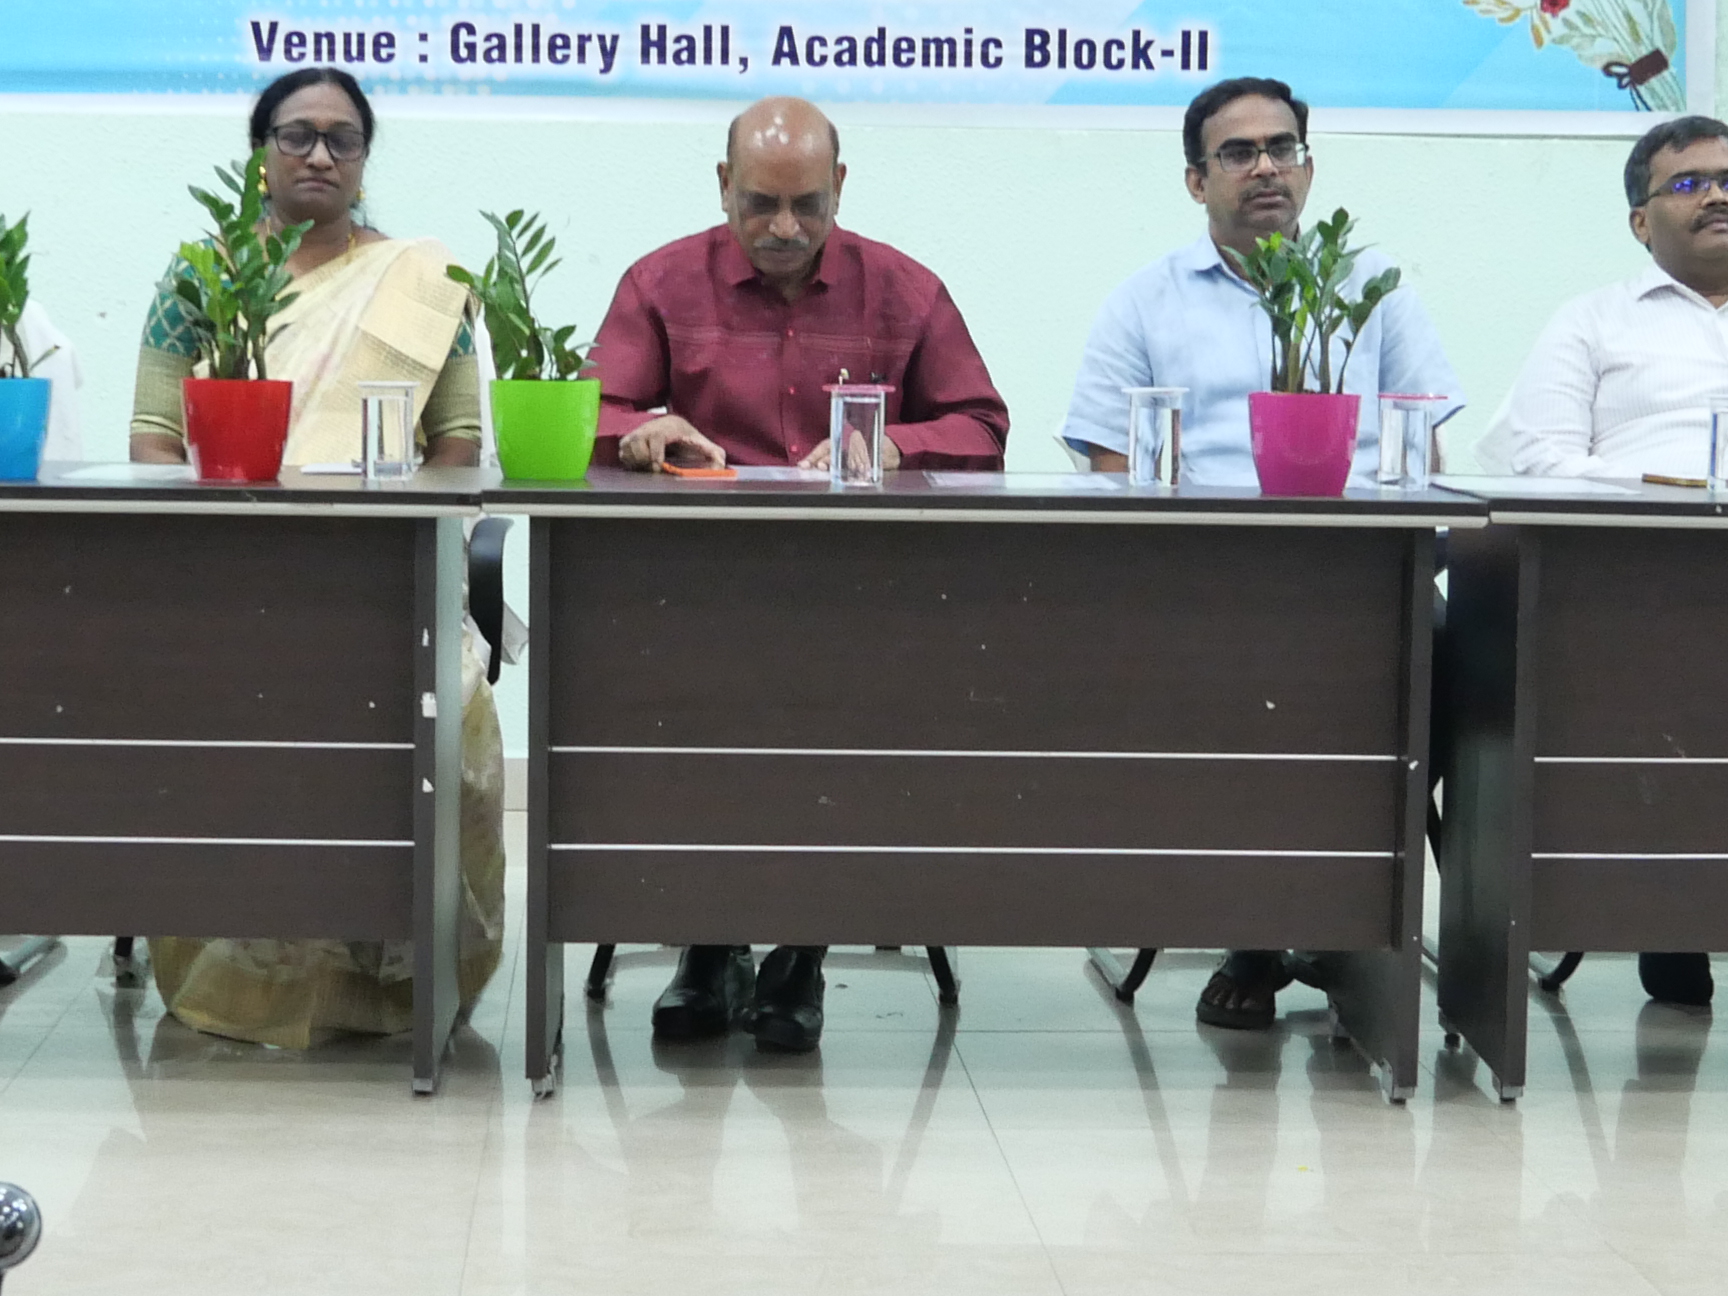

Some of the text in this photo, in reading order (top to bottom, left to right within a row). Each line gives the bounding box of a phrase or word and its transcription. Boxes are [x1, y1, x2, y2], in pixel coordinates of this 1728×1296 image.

[250, 20, 396, 64] Venue
[450, 21, 620, 75] Gallery
[640, 23, 749, 74] Hall,
[771, 25, 1003, 69] Academic
[1024, 28, 1209, 71] Block-II
